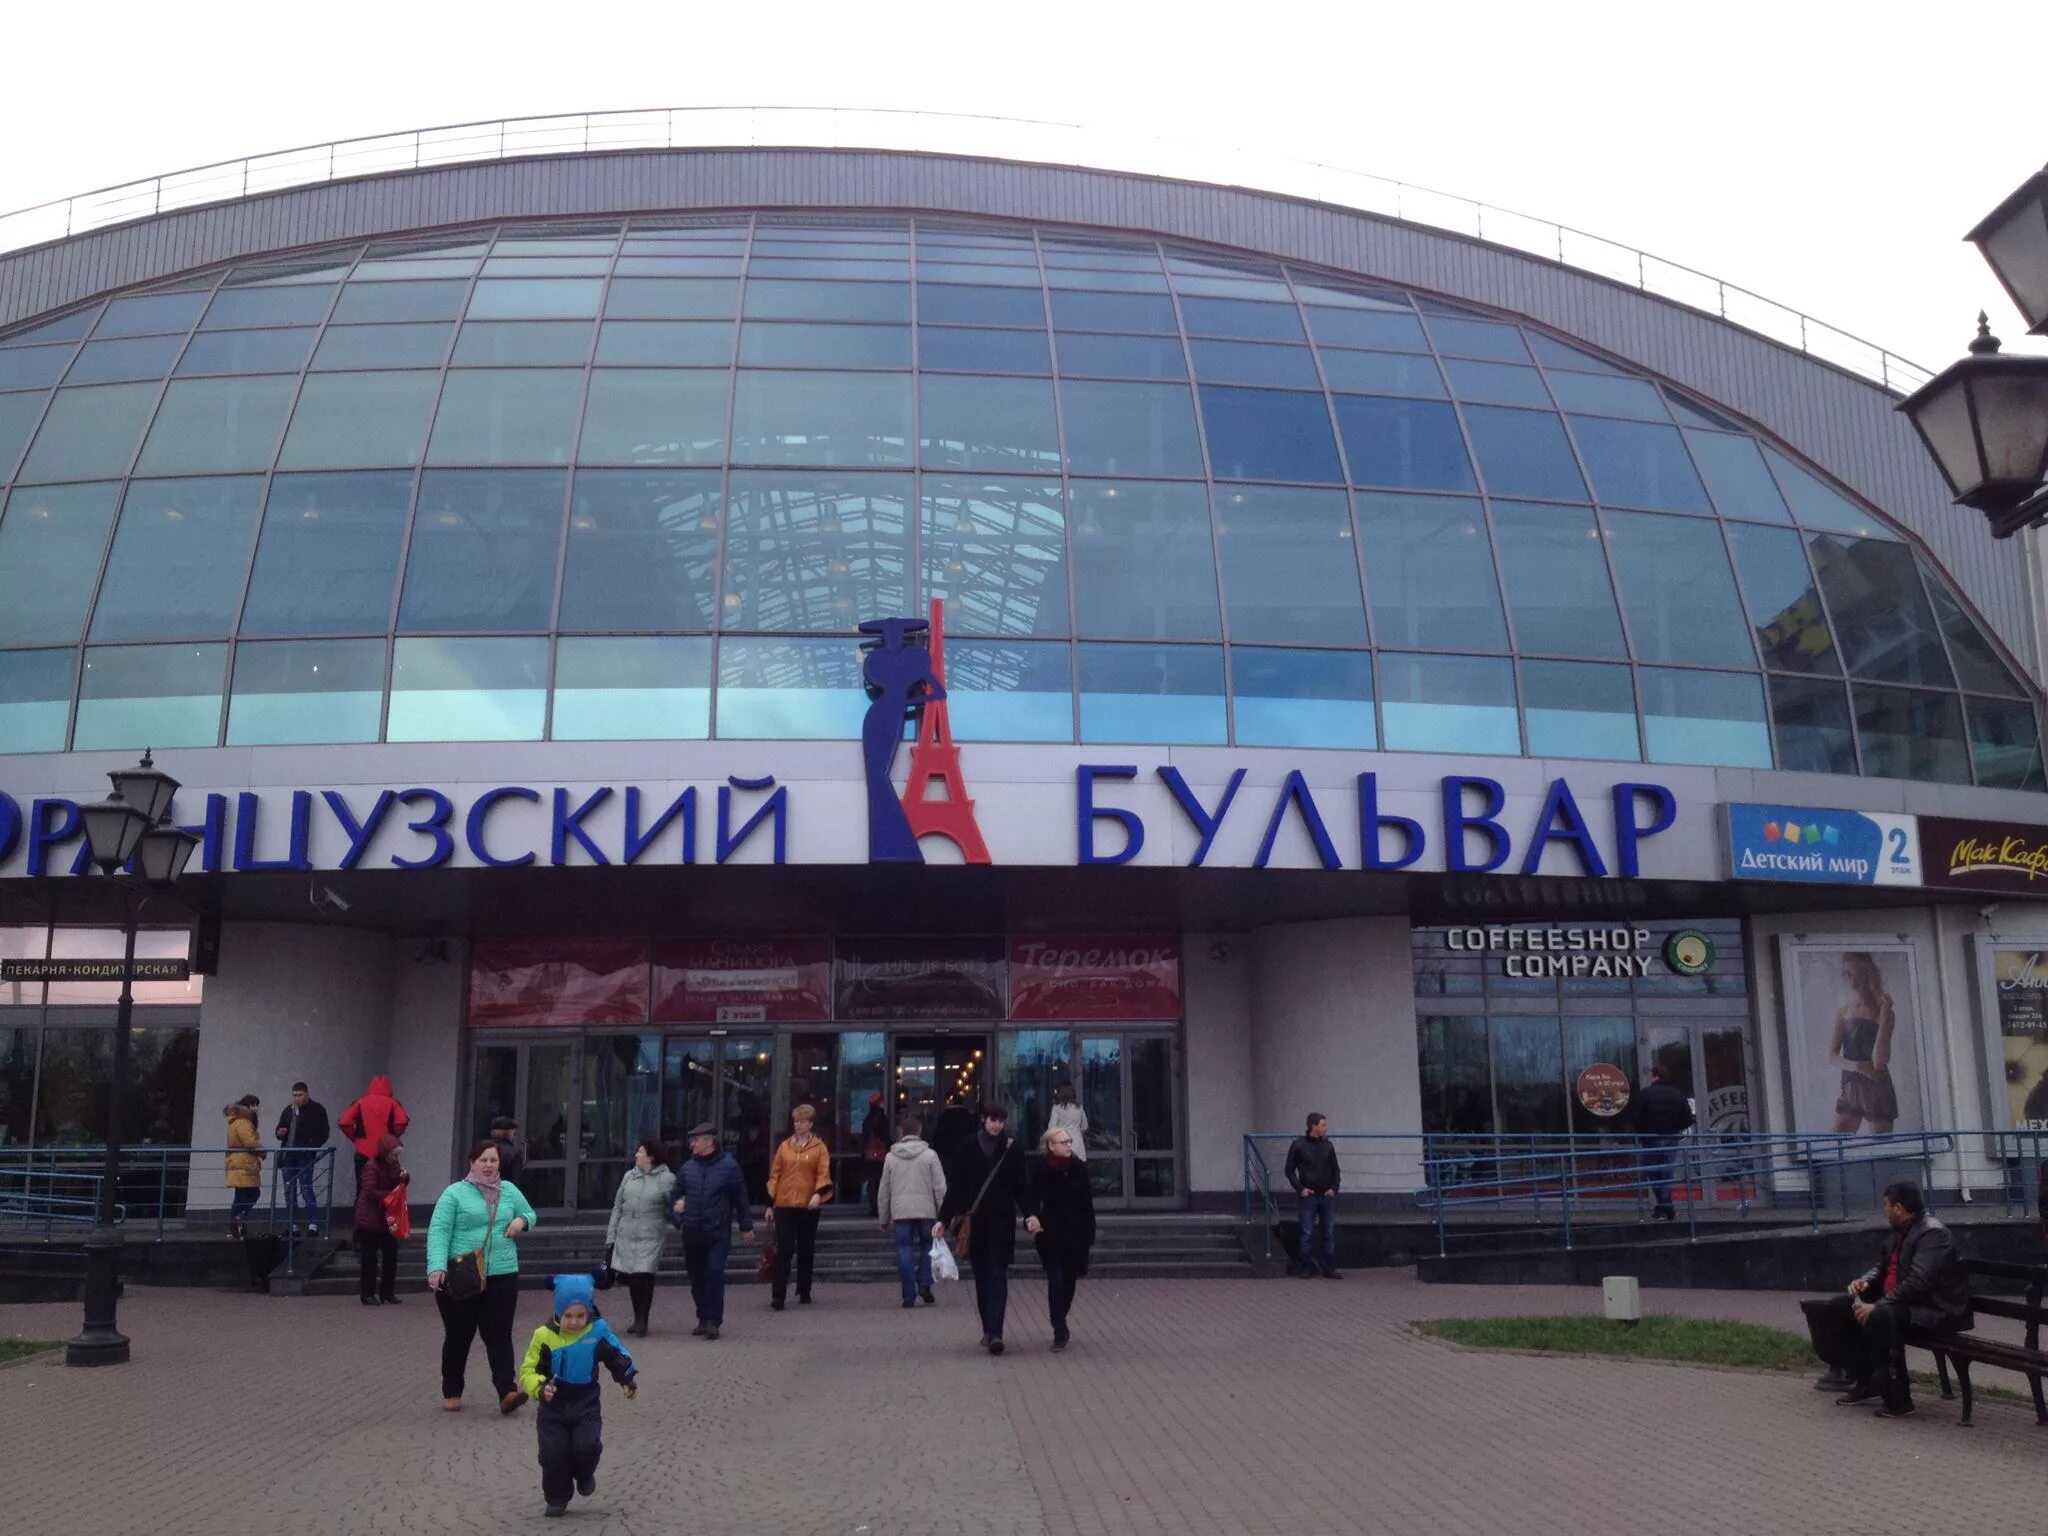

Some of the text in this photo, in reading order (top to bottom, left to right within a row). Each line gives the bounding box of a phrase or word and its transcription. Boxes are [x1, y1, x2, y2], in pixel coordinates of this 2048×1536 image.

[1075, 764, 1677, 877] БУЛЬВАР
[1888, 827, 1910, 864] 2
[1741, 847, 1869, 880] Детский мир
[1447, 928, 1651, 951] COFFEESHOP
[1018, 942, 1173, 978] Теремок
[1505, 954, 1652, 977] COMPANY
